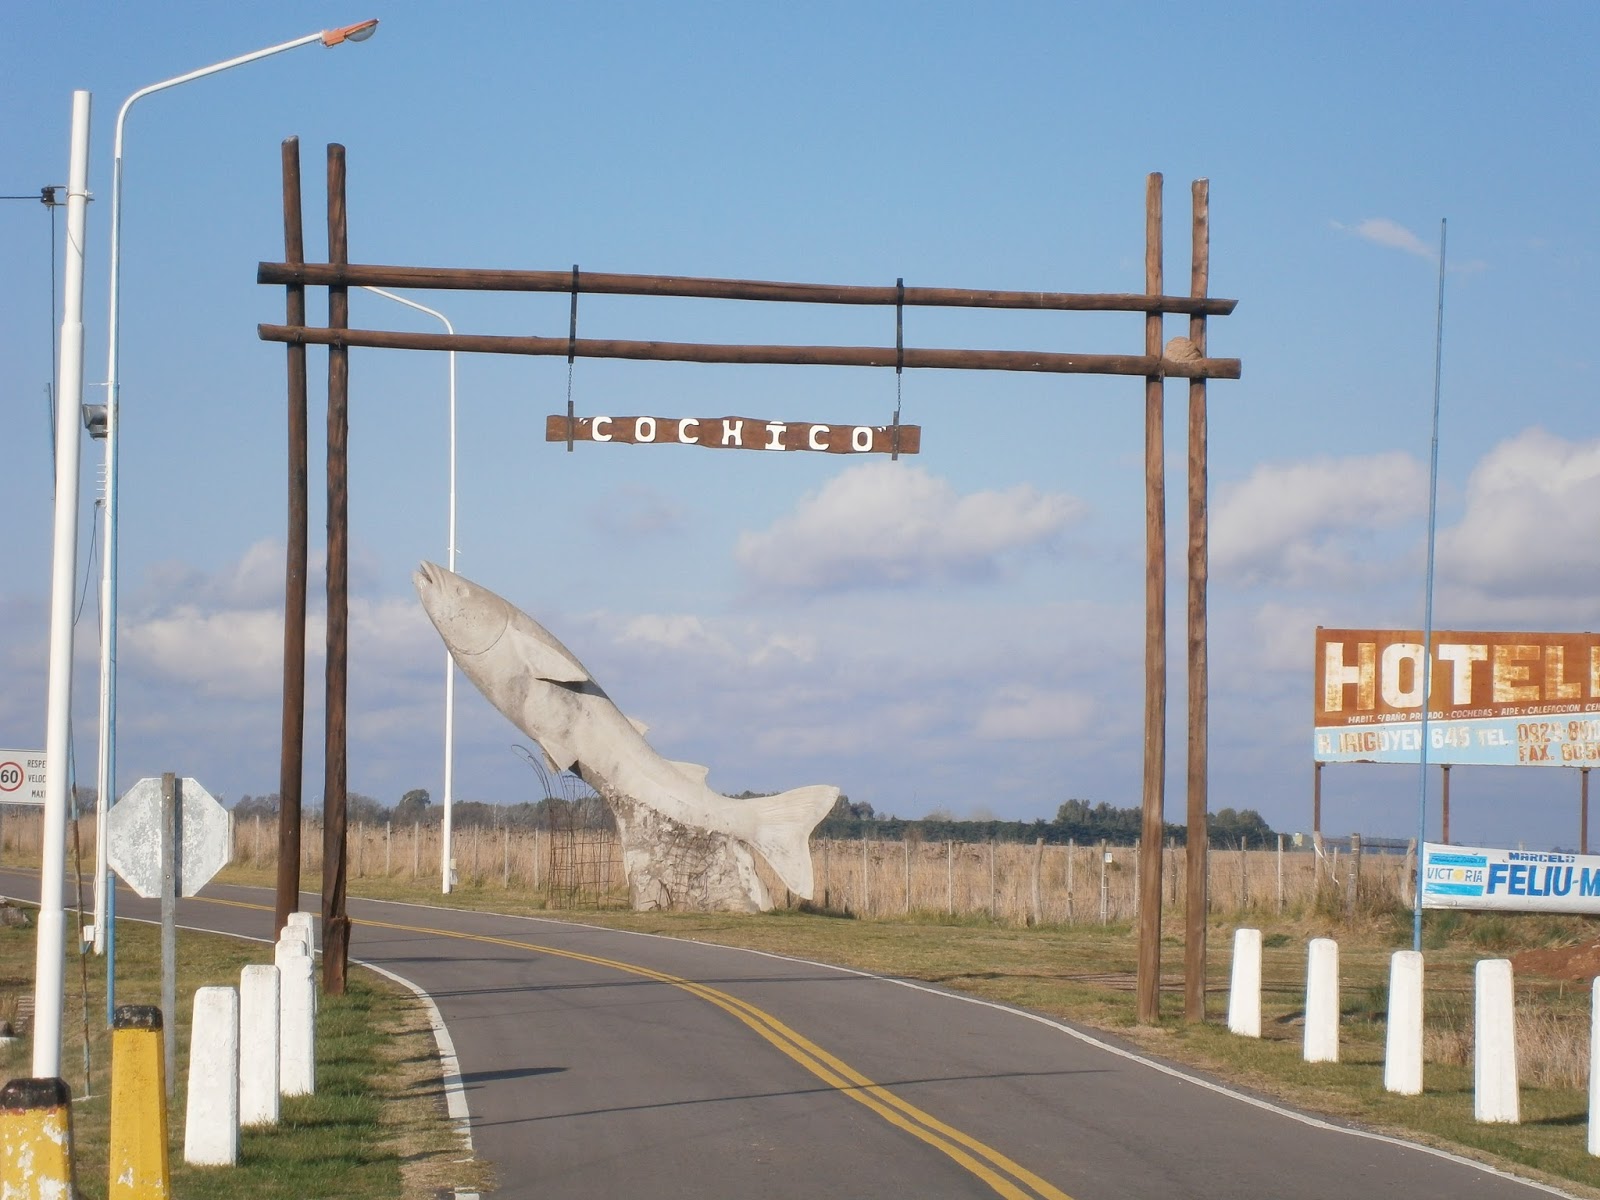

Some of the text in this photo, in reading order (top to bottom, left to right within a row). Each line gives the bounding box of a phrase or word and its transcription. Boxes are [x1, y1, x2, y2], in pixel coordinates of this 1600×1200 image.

[1348, 715, 1375, 724] HABIT.
[1410, 711, 1444, 721] PRIADO
[1451, 708, 1493, 718] COCHERAS
[1501, 706, 1519, 716] AIRE
[1527, 704, 1581, 715] CALEFACCION
[1431, 726, 1470, 749] 645
[1475, 728, 1513, 746] TEL.
[1519, 745, 1554, 761] FAX.
[1, 770, 18, 783] 60
[1508, 852, 1575, 863] MARCELO
